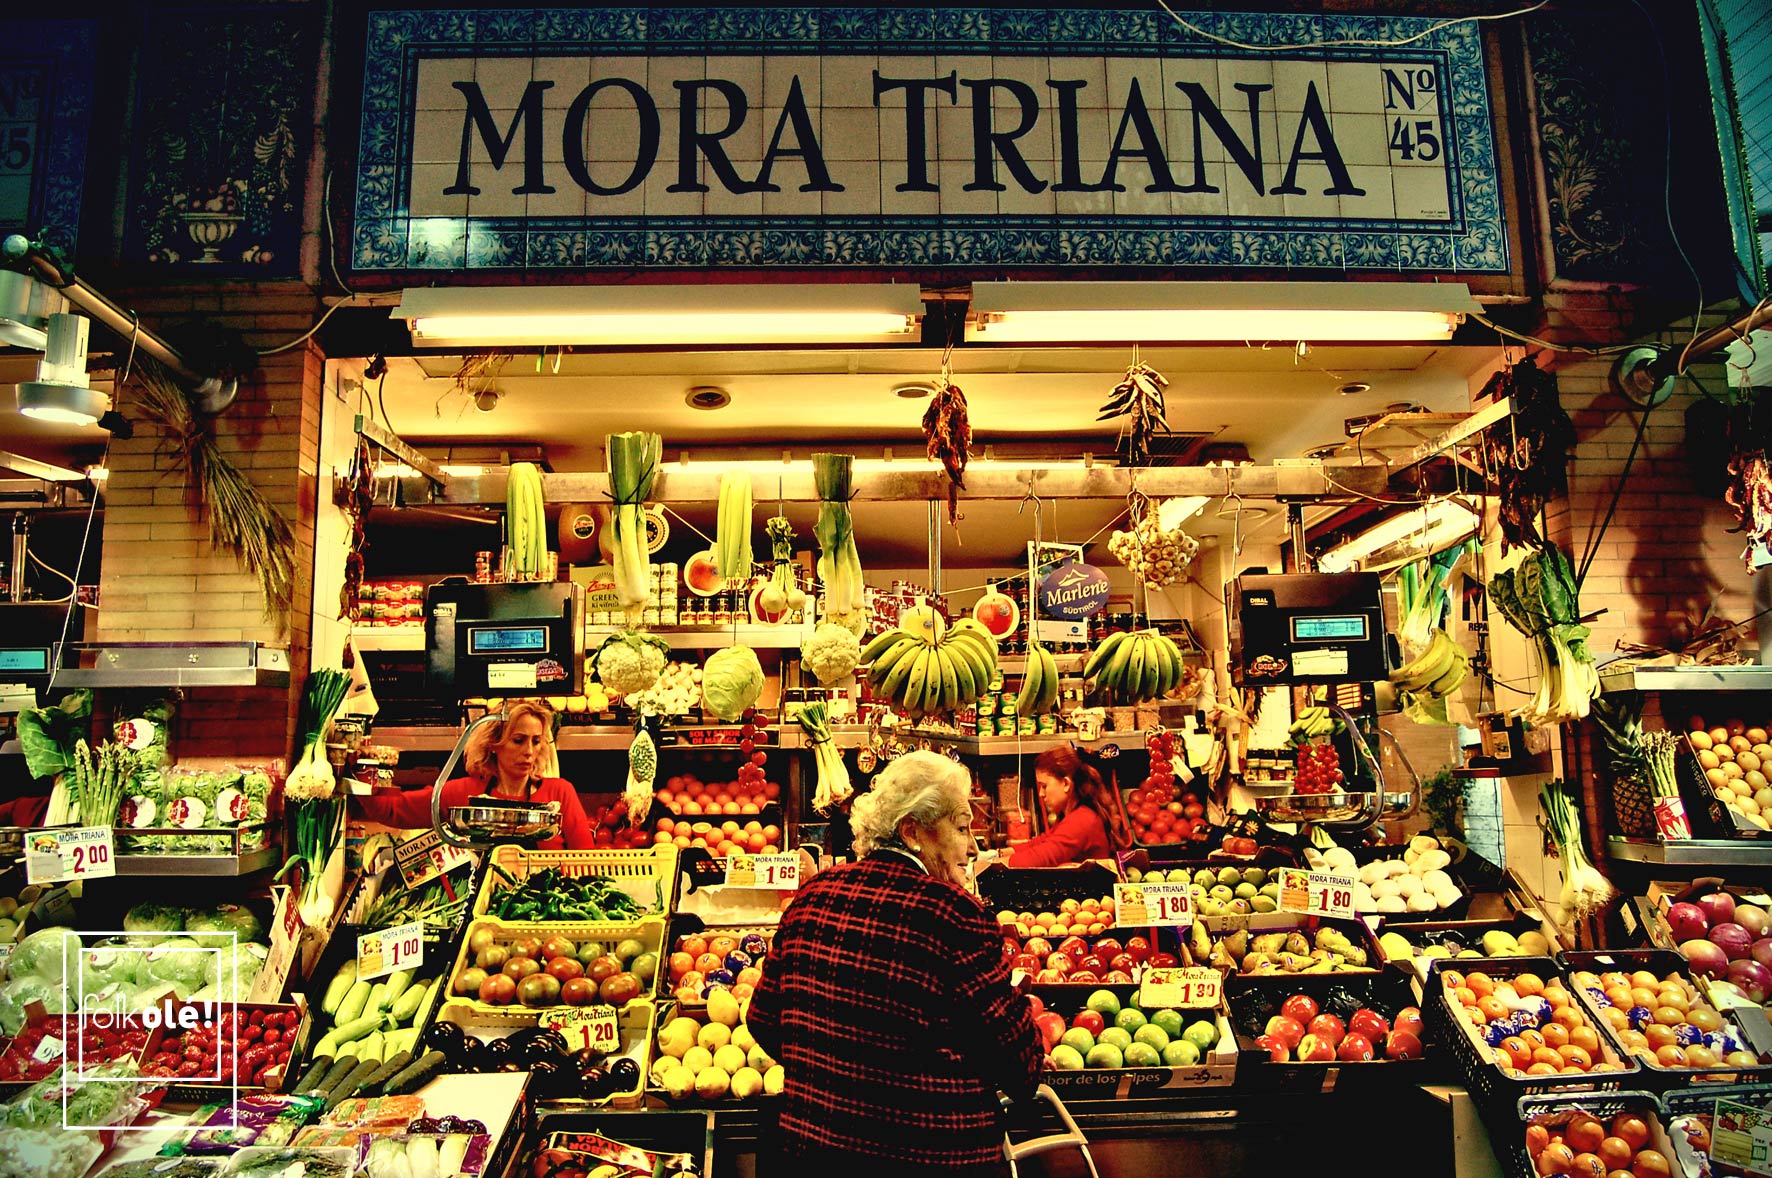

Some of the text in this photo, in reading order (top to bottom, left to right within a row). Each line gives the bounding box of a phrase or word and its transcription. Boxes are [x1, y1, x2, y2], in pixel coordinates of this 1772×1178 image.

[443, 69, 1366, 197] MORA TRIANA
[1390, 115, 1441, 162] 45
[1046, 580, 1109, 607] Marlene
[1062, 600, 1098, 614] SÜDTIROL
[1468, 622, 1489, 632] REPA
[58, 830, 106, 843] MORA TRIANA
[398, 840, 426, 857] MORA
[1310, 874, 1351, 886] MORA TRIANA
[1162, 885, 1185, 893] TRIANA
[1075, 1074, 1093, 1085] de
[1096, 1073, 1117, 1084] los
[1132, 1072, 1161, 1084] lpes
